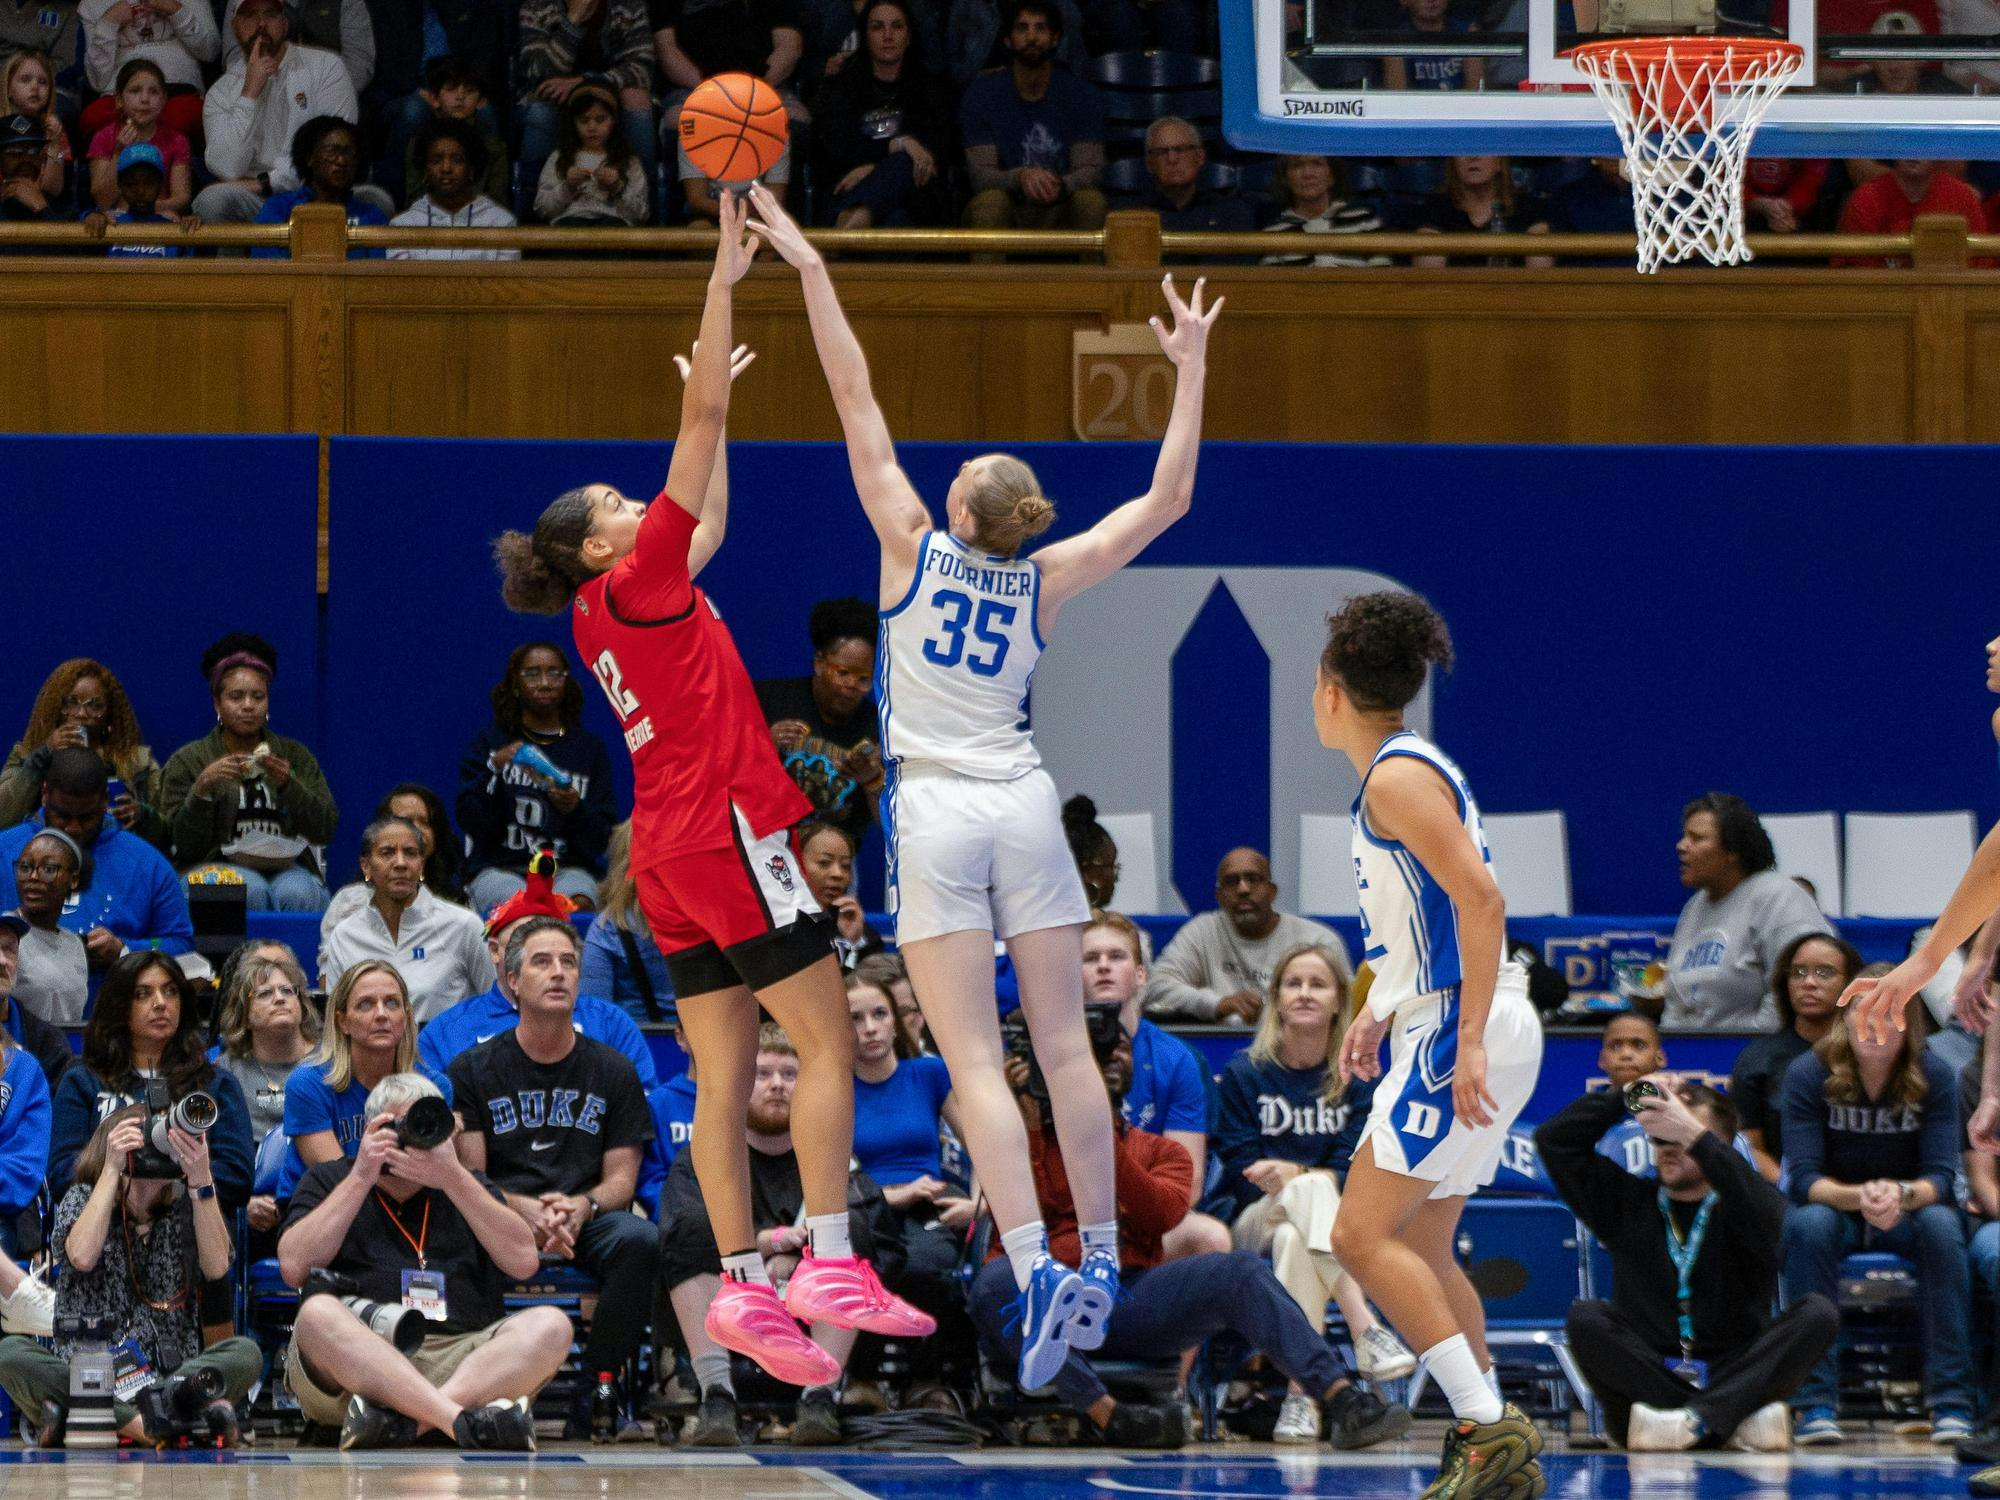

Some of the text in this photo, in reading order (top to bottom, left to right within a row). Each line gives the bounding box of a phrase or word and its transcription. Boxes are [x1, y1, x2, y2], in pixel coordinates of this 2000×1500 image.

[1283, 98, 1364, 117] SPALDING
[1087, 362, 1178, 435] 20
[924, 548, 1032, 597] FOURNIER
[921, 588, 1017, 677] 35
[592, 648, 641, 723] 12
[624, 716, 655, 754] IERRE
[338, 1114, 363, 1144] DU
[487, 1087, 607, 1135] DUKE
[1827, 1102, 1920, 1133] DUKE
